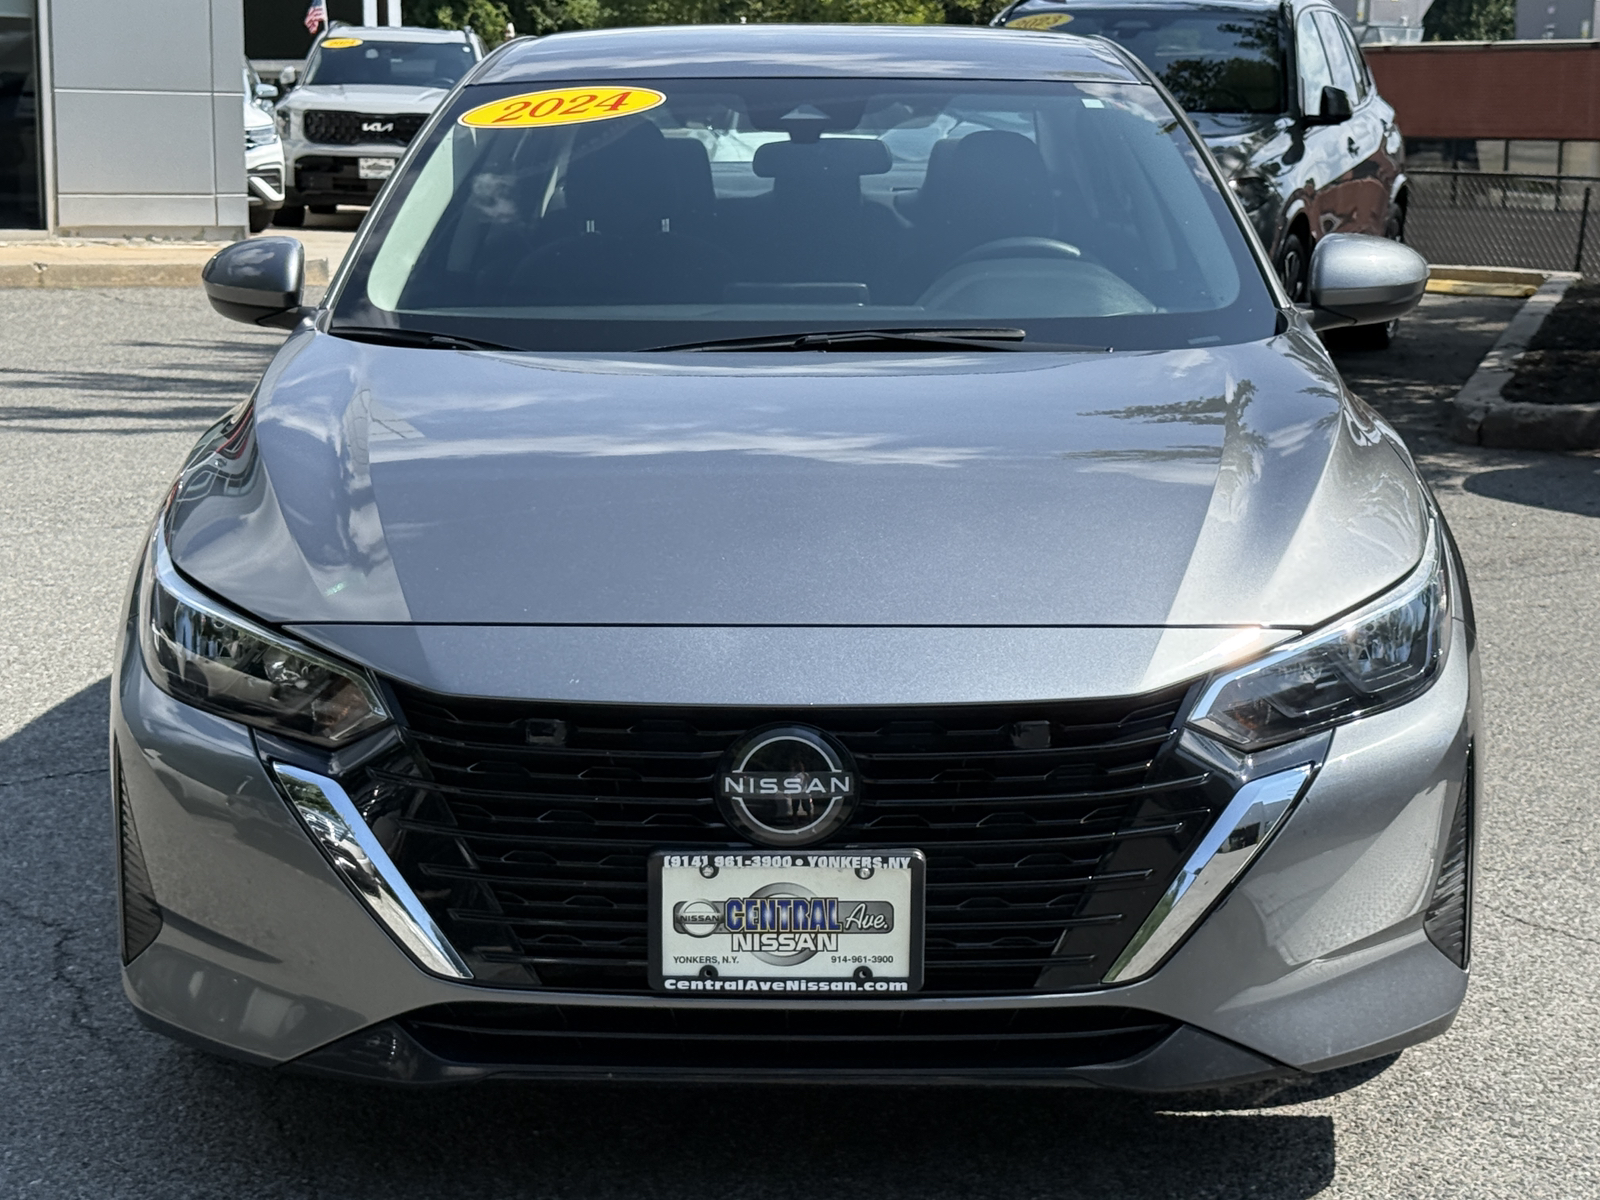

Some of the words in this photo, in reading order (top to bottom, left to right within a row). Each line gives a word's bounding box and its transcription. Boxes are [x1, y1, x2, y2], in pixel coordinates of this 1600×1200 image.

[491, 91, 633, 123] 2024
[725, 776, 850, 794] NISSAN
[714, 855, 792, 868] 961-3900
[679, 914, 720, 922] NISSAN
[724, 897, 843, 933] CENTRAL
[845, 903, 889, 930] Ave.
[731, 933, 838, 952] NISSAN
[673, 955, 720, 965] YONKERS,
[722, 955, 740, 964] N.Y.
[831, 955, 894, 964] 914-961-3900
[664, 979, 908, 992] CentralAveNissan.com
